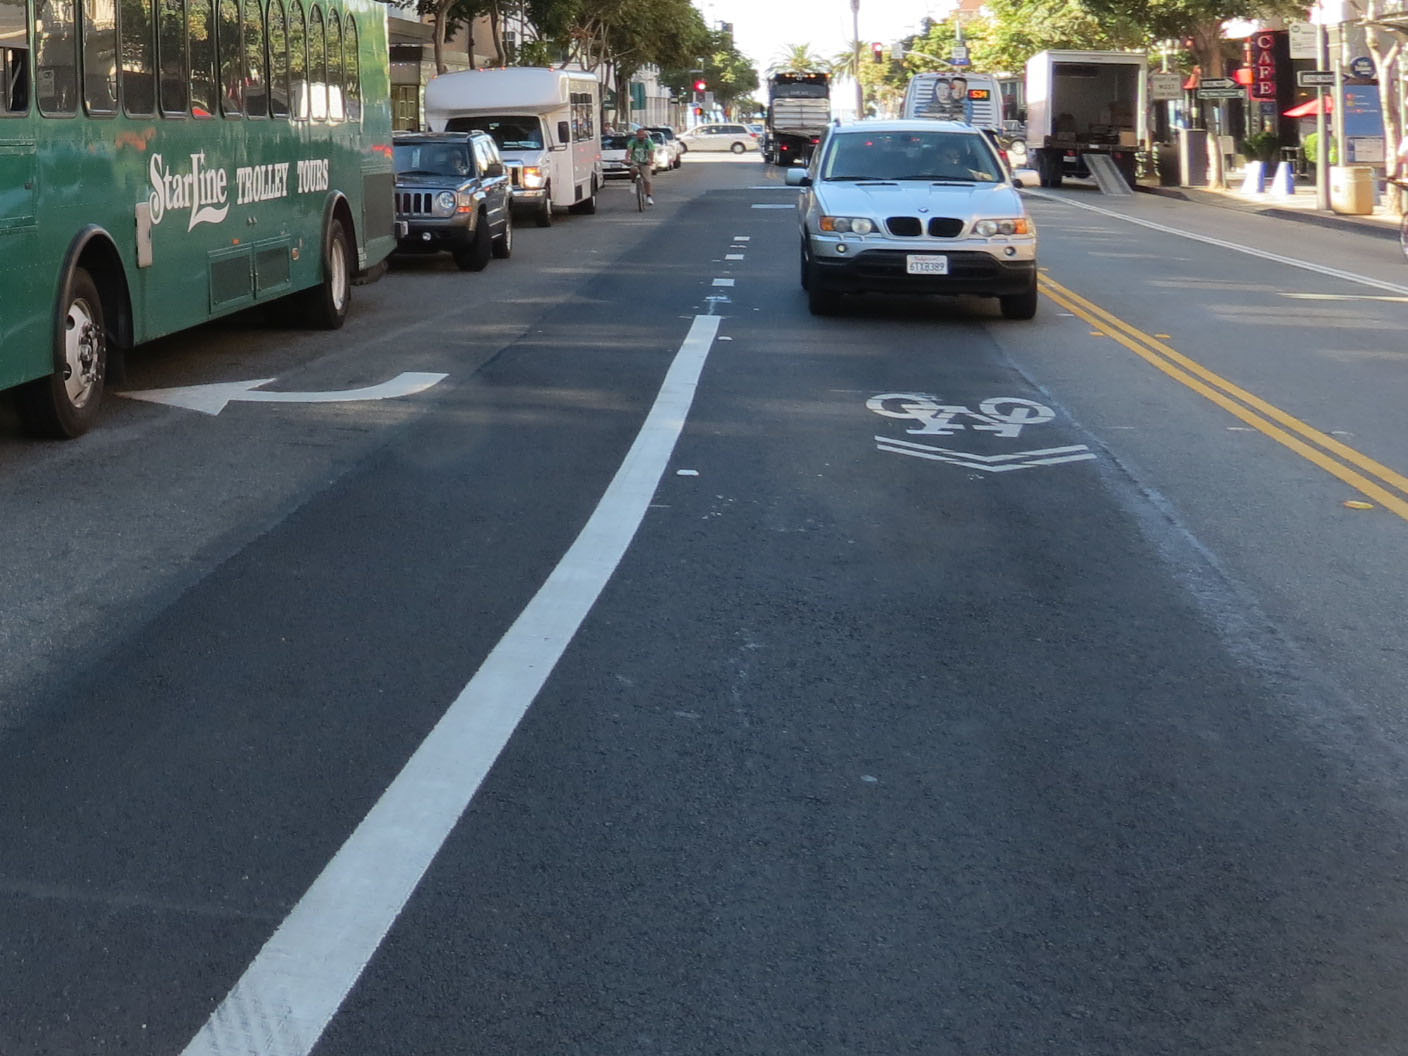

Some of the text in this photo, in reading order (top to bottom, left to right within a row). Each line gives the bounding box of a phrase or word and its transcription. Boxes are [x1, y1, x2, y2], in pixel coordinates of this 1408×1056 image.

[1257, 35, 1273, 95] CAFE
[149, 148, 329, 232] StarLine TROLLEY TOURS
